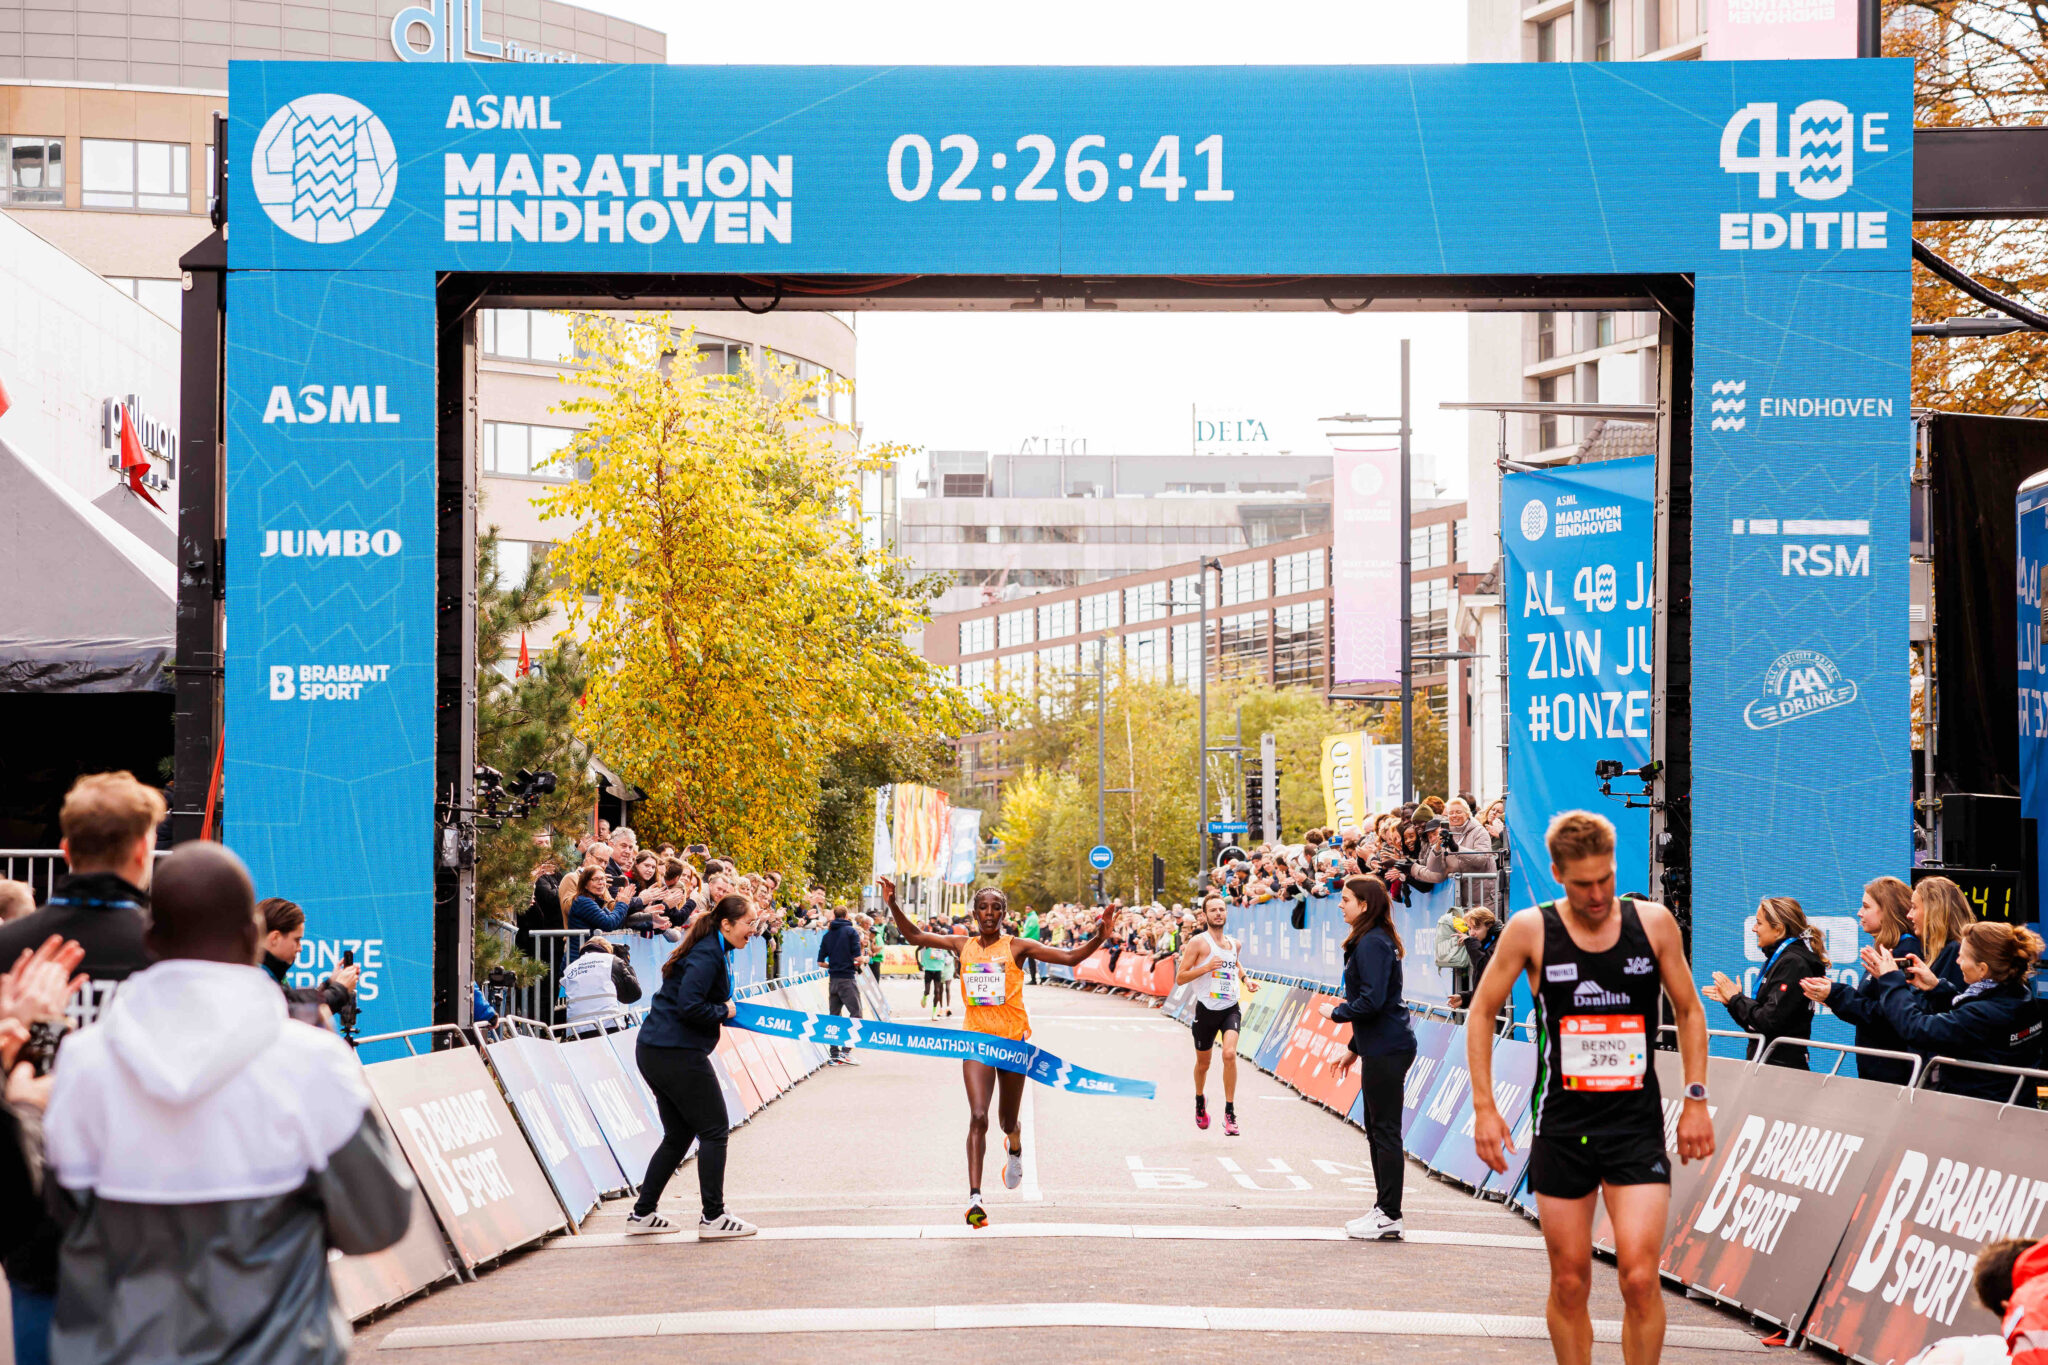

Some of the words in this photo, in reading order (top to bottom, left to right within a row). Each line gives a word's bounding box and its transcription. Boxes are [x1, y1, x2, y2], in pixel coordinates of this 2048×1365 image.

[446, 95, 561, 130] ASML
[444, 153, 793, 197] MARATHON
[887, 133, 1235, 203] 02:26:41
[444, 200, 793, 244] EINDHOVEN
[1719, 211, 1889, 250] EDITIE
[263, 384, 401, 424] ASML
[1759, 397, 1894, 418] EINDHOVEN
[1197, 418, 1269, 441] DELA
[1555, 495, 1578, 507] ASML
[1555, 506, 1622, 525] MARATHON
[260, 529, 402, 558] JUMBO
[1555, 522, 1622, 538] EINDHOVEN
[1782, 544, 1870, 577] RSM
[1523, 569, 1566, 618] AL
[1527, 628, 1601, 680] ZIJN
[299, 664, 390, 682] BRABANT
[1785, 666, 1828, 699] AA
[299, 683, 363, 700] SPORT
[1779, 690, 1838, 717] DRINK
[1528, 690, 1649, 742] #ONZE
[1329, 740, 1357, 835] UMBO
[1387, 747, 1402, 798] RSM
[966, 975, 1000, 983] JEROTICH
[977, 984, 988, 992] F2
[1573, 991, 1631, 1007] Danilith
[755, 1015, 793, 1032] ASML
[869, 1031, 904, 1047] ASML
[907, 1035, 975, 1054] MARATHON
[1581, 1040, 1627, 1051] BERND
[1589, 1053, 1618, 1067] 376
[1075, 1077, 1118, 1093] ASML
[420, 1089, 503, 1152] BRABANT
[1750, 1119, 1865, 1196] BRABANT
[451, 1147, 515, 1208] SPORT
[1719, 1184, 1802, 1255] SPORT
[1881, 1234, 1978, 1327] SPORT
